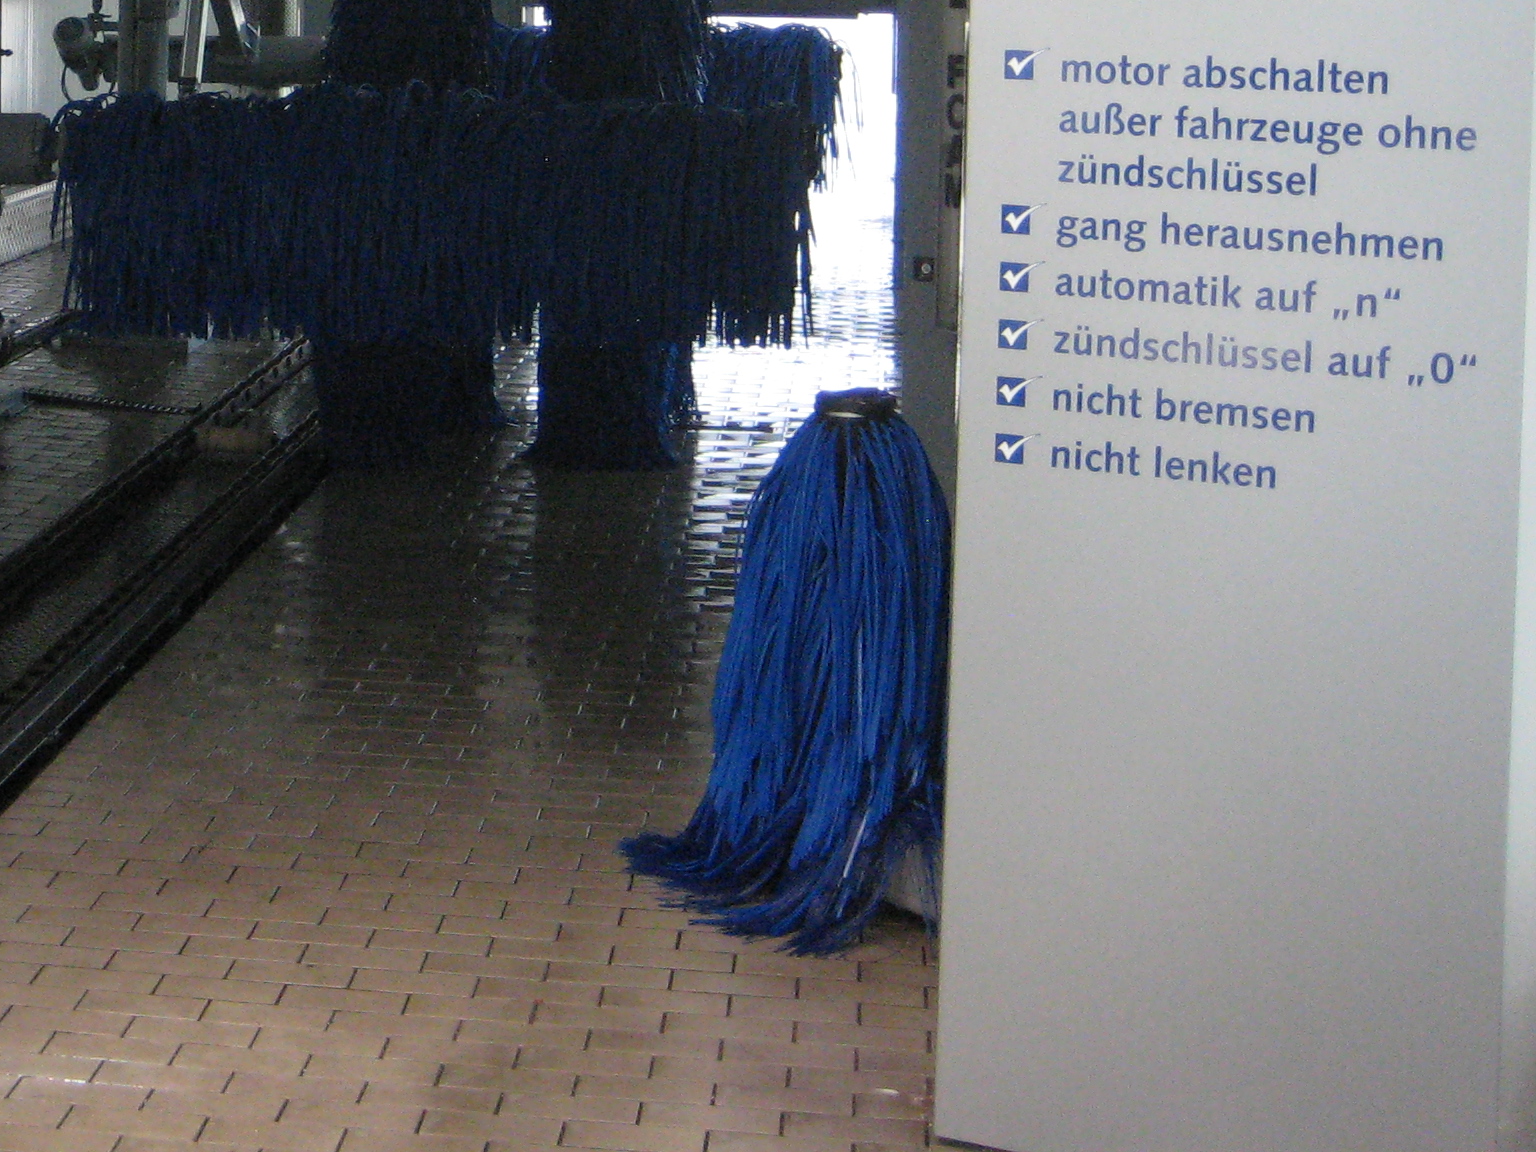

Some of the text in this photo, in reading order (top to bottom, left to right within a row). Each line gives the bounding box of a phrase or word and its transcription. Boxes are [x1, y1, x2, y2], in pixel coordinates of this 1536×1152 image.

[1061, 56, 1389, 95] motor abschalten
[1059, 103, 1478, 154] außer fahrzeuge ohne
[1058, 155, 1318, 196] zündschlüssel
[1056, 213, 1443, 261] gang herausnehmen
[1056, 270, 1240, 308] automatik
[1255, 282, 1317, 313] auf
[1053, 325, 1312, 373] zündschlüssel
[1328, 347, 1391, 379] auf
[1052, 386, 1316, 433] nicht bremsen
[1051, 442, 1276, 489] nicht lenken
